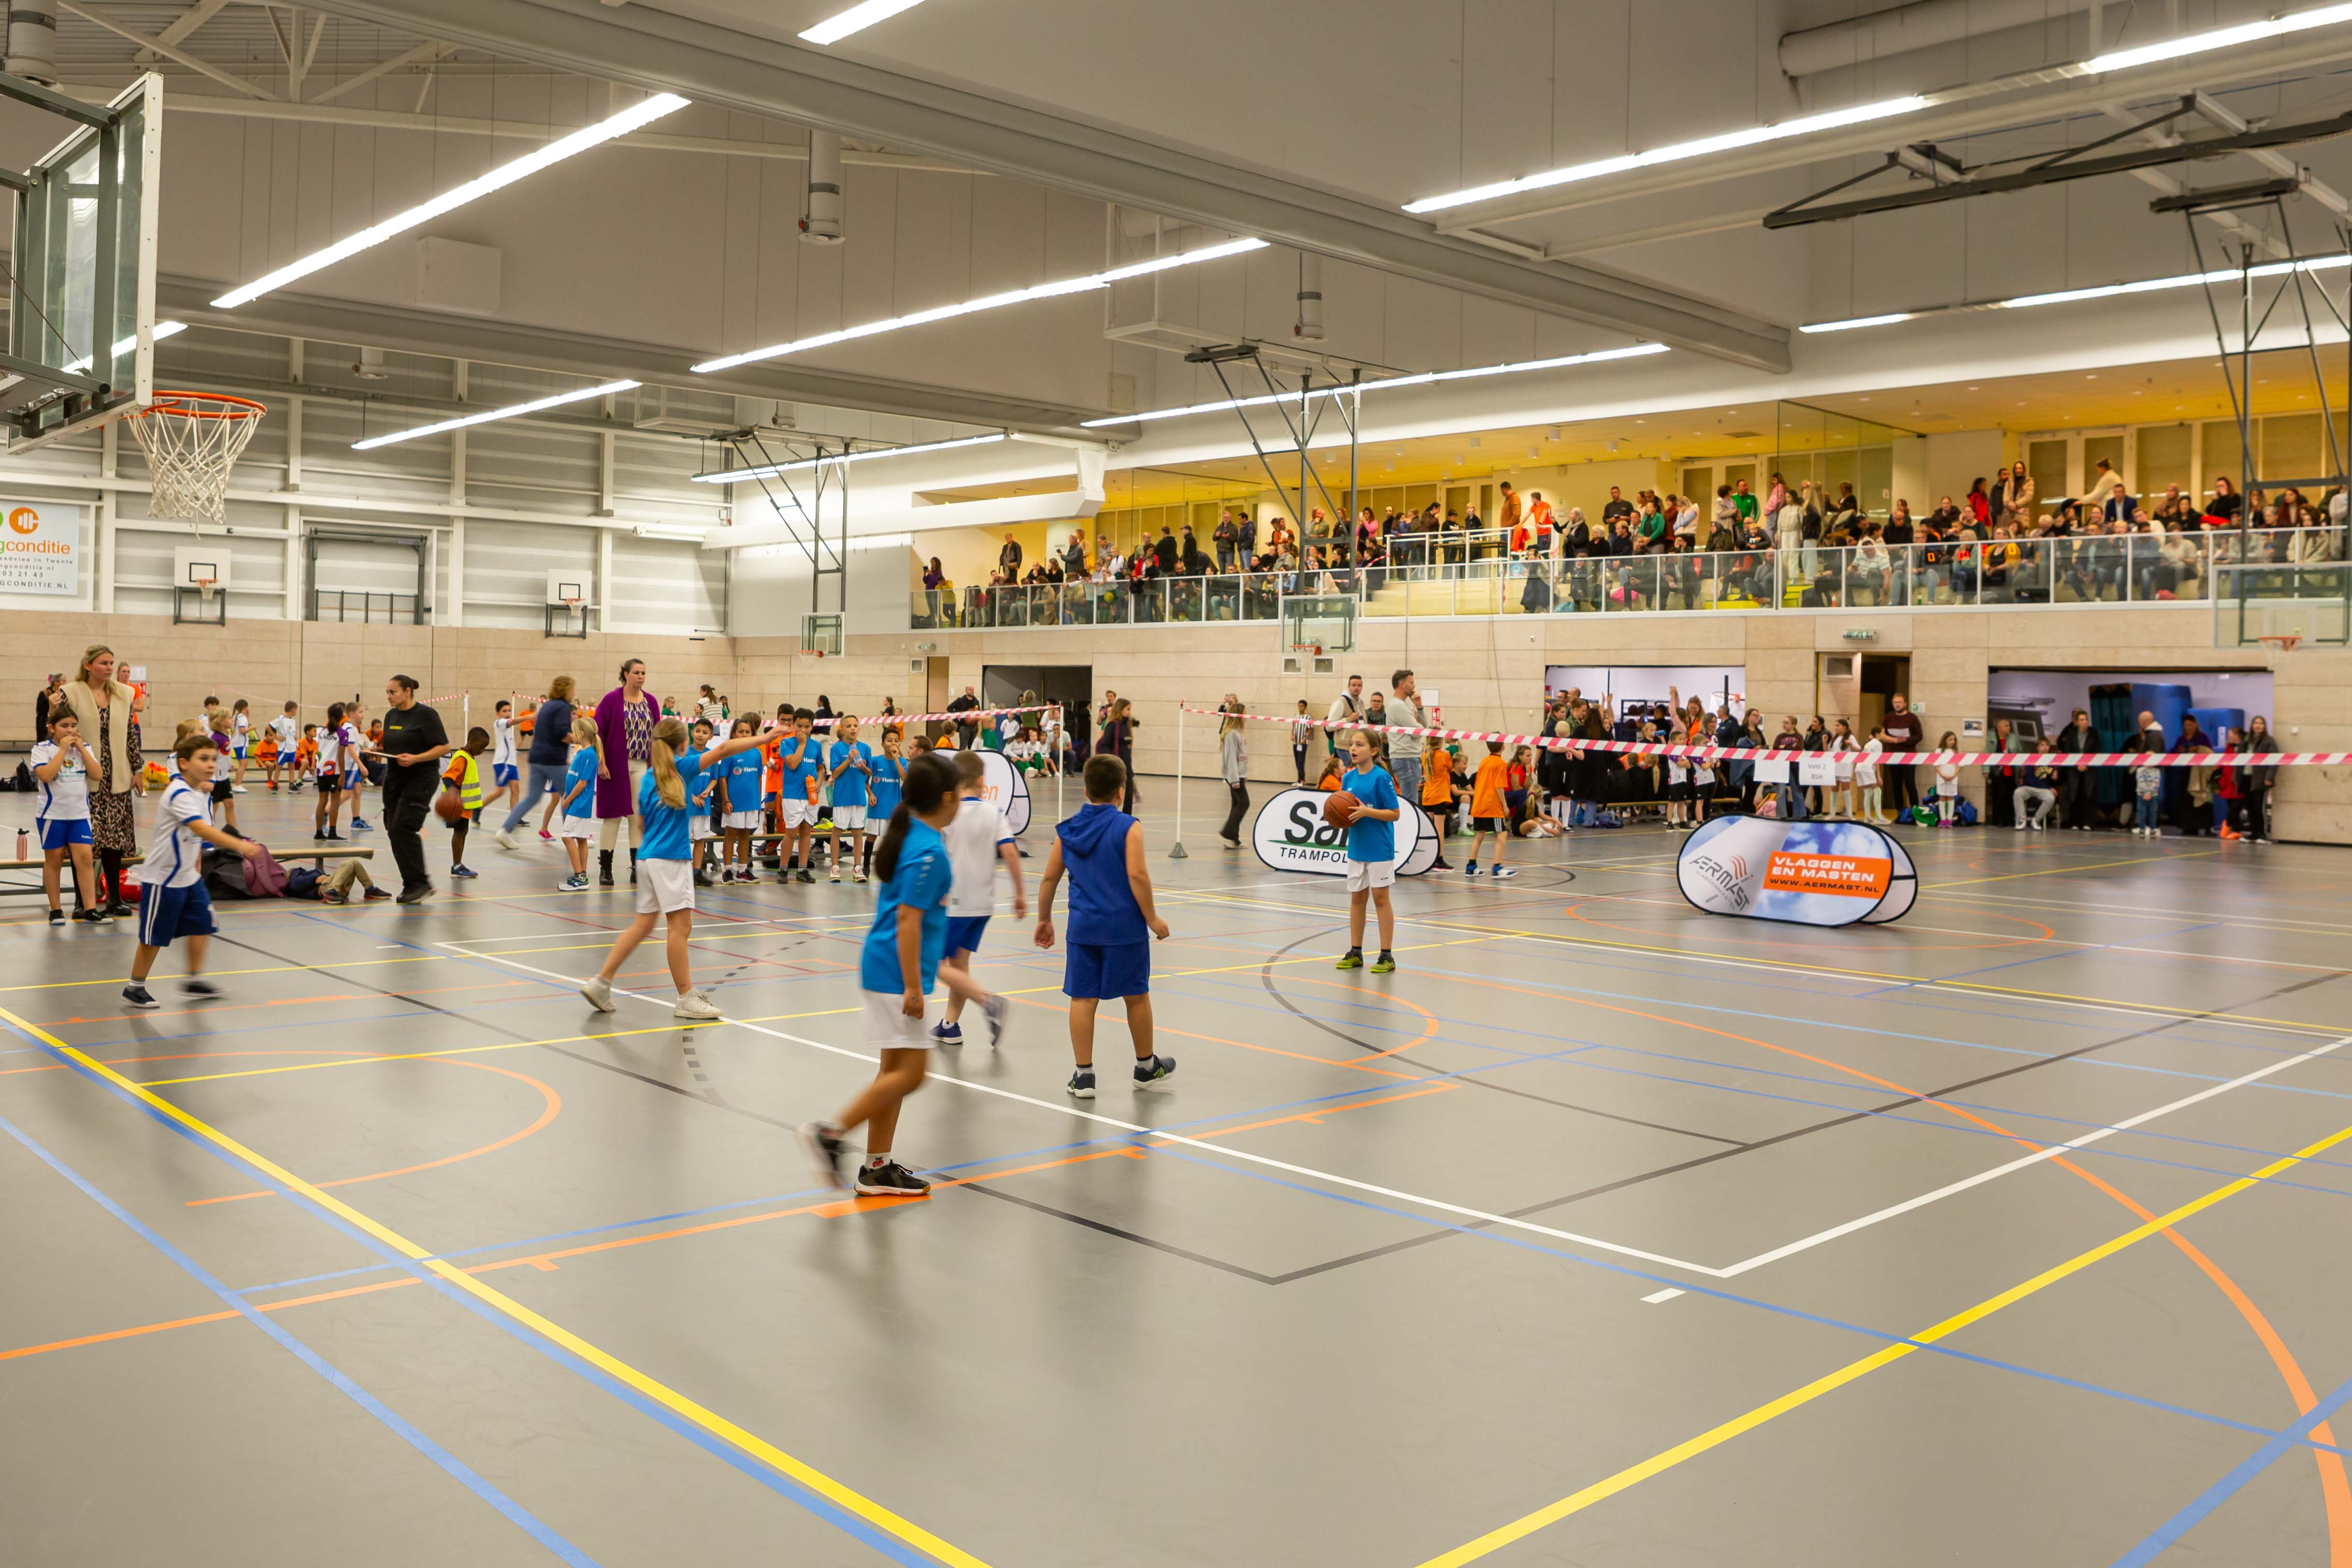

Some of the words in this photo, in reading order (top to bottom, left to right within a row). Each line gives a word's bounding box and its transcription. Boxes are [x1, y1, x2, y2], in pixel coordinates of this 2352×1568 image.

[1774, 856, 1856, 870] VLAGGEN
[1772, 867, 1795, 876] EN
[1801, 869, 1874, 882] MASTEN
[1770, 879, 1880, 893] WWW.AERMAST.NL
